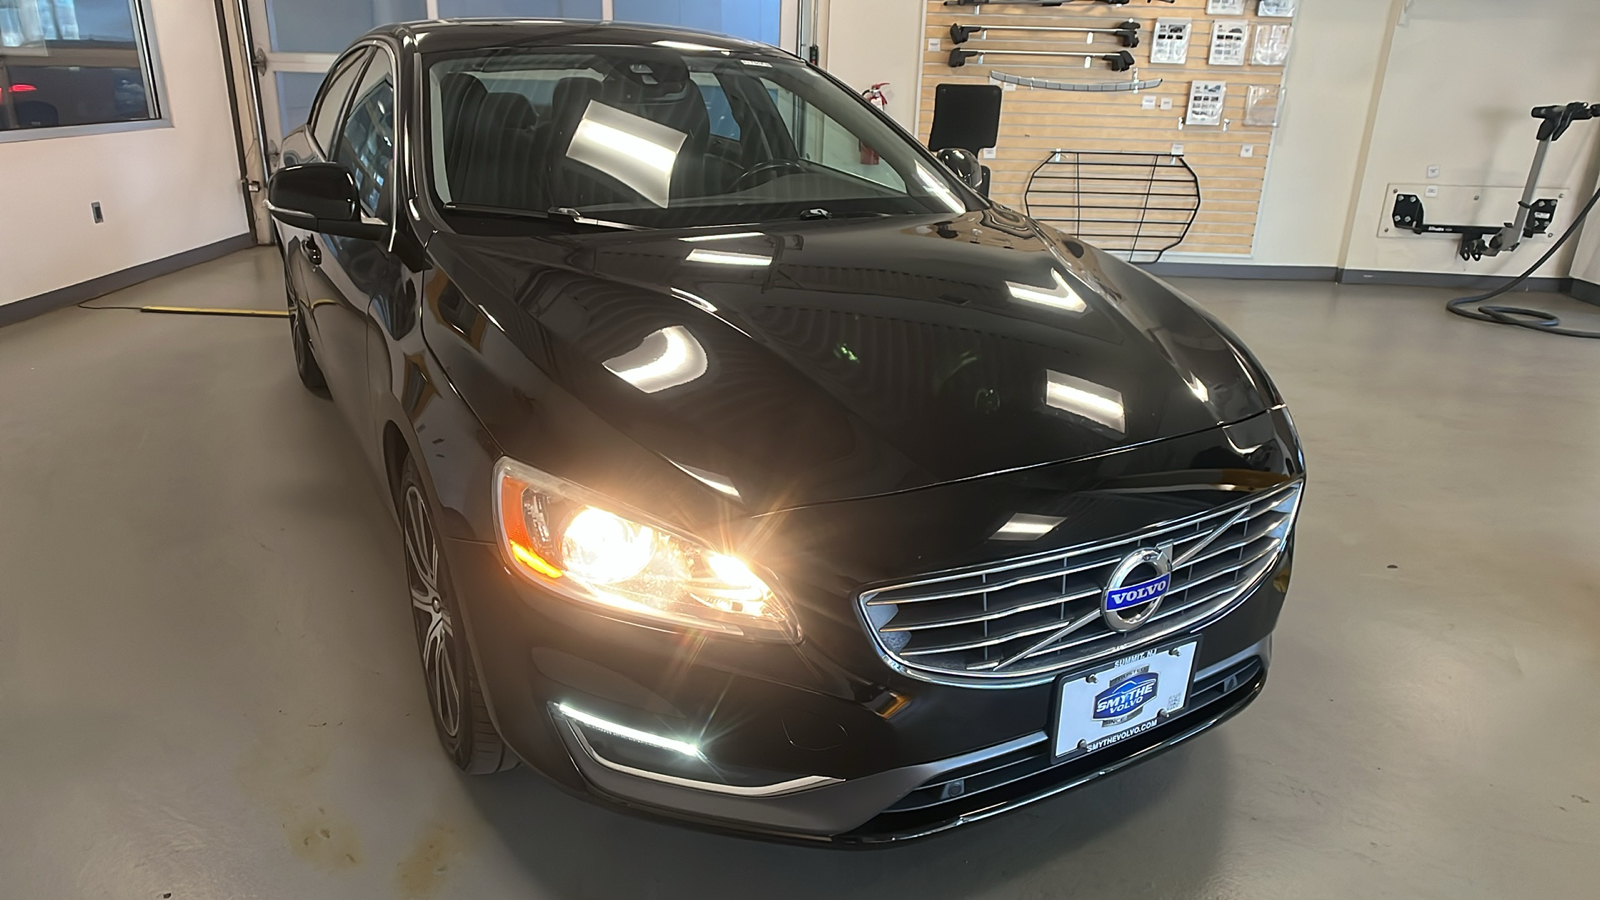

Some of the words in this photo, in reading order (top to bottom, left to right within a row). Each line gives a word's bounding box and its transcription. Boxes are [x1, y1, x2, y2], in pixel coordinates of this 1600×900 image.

[1111, 580, 1167, 605] VOLVO
[1147, 648, 1157, 657] NJ
[1096, 682, 1154, 713] SMYTHE
[1109, 696, 1143, 714] VOLVO
[1086, 719, 1158, 752] SMYTHEVOLVO.COM
